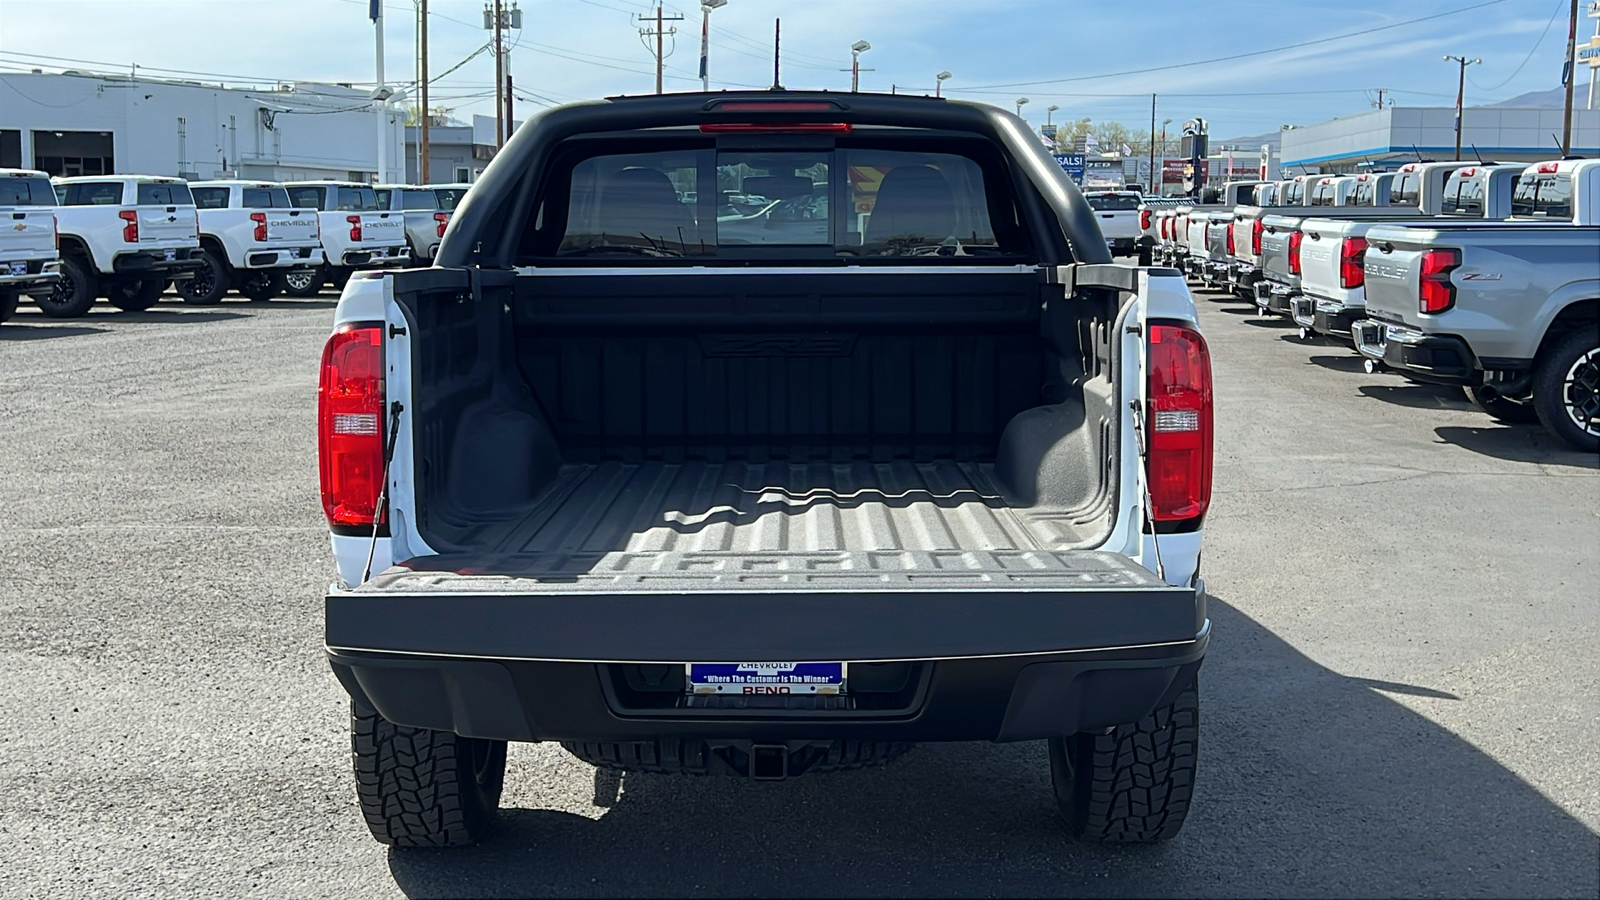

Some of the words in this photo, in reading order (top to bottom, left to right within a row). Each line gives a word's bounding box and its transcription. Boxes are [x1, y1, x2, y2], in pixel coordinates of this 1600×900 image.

[364, 221, 403, 229] CHEVROLET
[732, 675, 745, 683] The
[746, 675, 780, 683] Customer
[781, 675, 788, 683] Is
[789, 675, 803, 683] The
[742, 686, 791, 695] RENO
